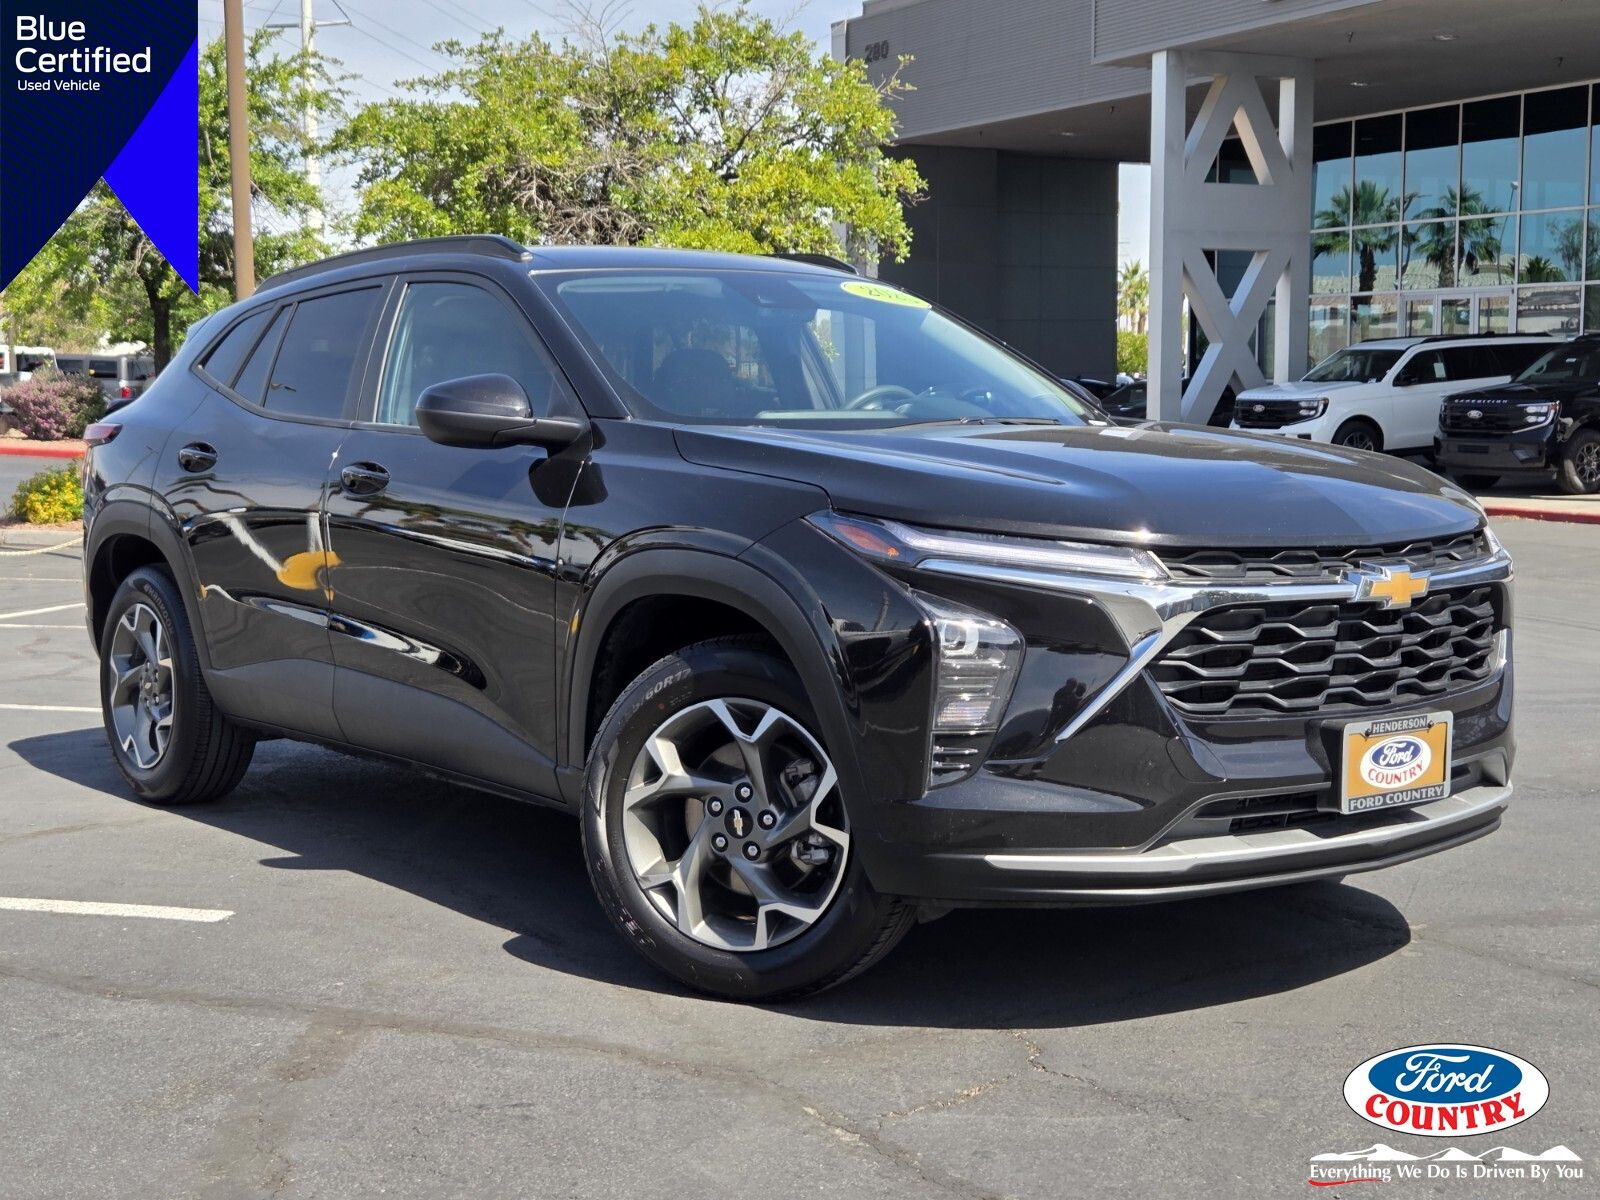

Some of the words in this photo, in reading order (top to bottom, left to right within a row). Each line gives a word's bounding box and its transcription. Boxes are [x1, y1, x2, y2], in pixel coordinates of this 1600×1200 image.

[865, 40, 889, 63] 280
[1372, 717, 1427, 732] HENDERSON
[1379, 741, 1415, 766] Ford
[1368, 761, 1424, 785] COUNTRY
[1350, 796, 1383, 811] FORD
[1385, 785, 1444, 803] COUNTRY
